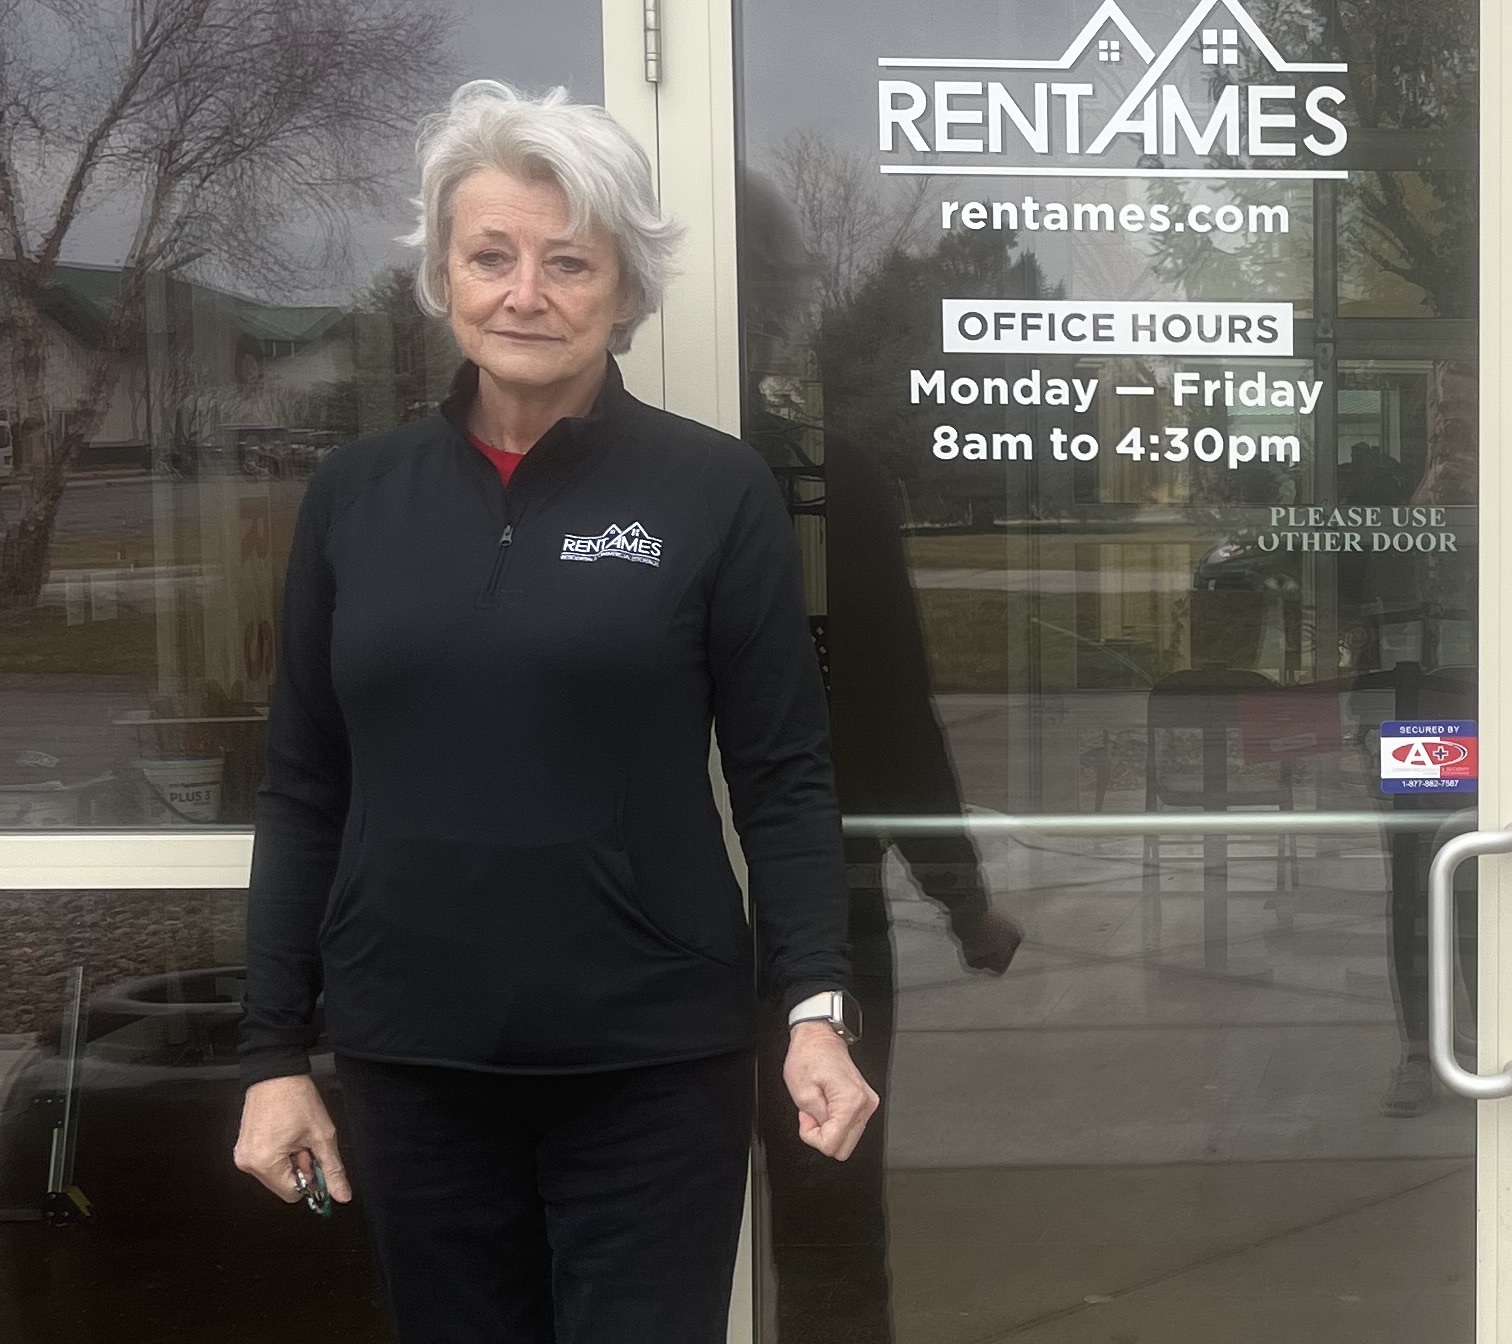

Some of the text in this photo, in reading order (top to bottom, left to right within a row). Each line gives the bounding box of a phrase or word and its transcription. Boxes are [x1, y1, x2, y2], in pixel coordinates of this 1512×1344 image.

[941, 197, 1289, 234] rentames.com
[957, 311, 1280, 344] OFFICE HOURS
[909, 370, 1099, 414] Monday
[1173, 372, 1324, 415] Friday
[932, 427, 1301, 468] 8am to 4:30pm
[1271, 507, 1447, 527] PLEASE USE
[1258, 532, 1458, 552] OTHER DOOR
[1399, 725, 1460, 735] SECURED BY
[170, 791, 202, 803] PLUS
